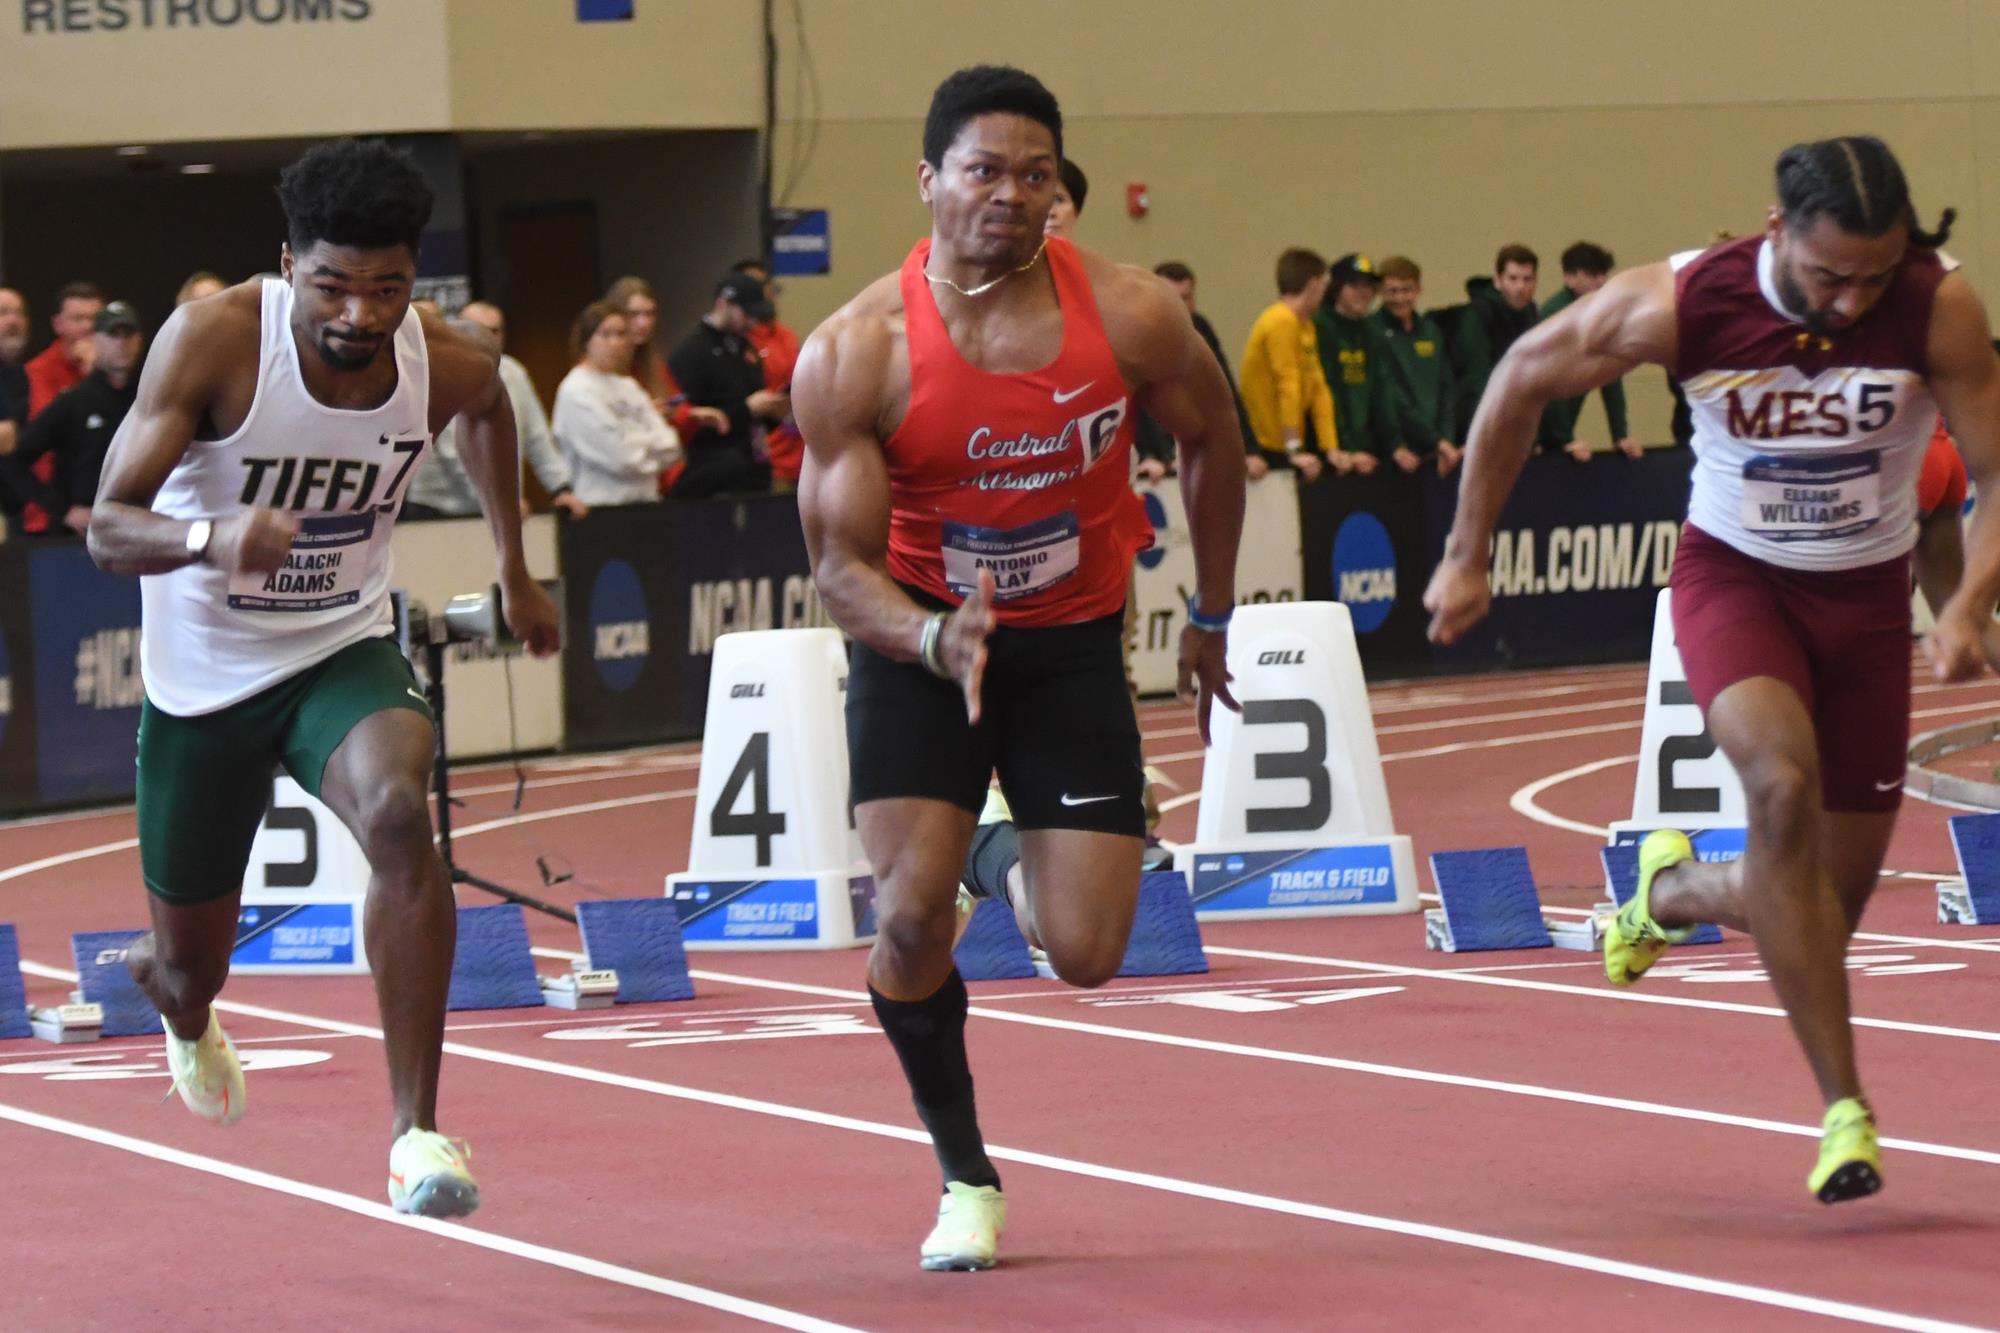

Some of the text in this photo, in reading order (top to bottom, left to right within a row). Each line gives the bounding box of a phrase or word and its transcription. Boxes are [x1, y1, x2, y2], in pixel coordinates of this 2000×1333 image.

[23, 0, 371, 33] RESTROOMS
[1727, 389, 1849, 439] MES
[1858, 384, 1896, 432] 5
[967, 418, 1077, 460] Central
[384, 440, 424, 499] 7
[240, 457, 395, 512] TIFFI
[1783, 488, 1841, 502] ELIJAH
[1760, 500, 1862, 523] WILLIAMS
[283, 552, 342, 570] ALACHI
[975, 551, 1048, 571] ANTONIO
[263, 572, 337, 593] ADAMS
[996, 570, 1031, 589] LAY
[1338, 568, 1397, 604] NCAA
[1257, 650, 1306, 665] GILL
[730, 683, 766, 698] GILL
[1658, 680, 1720, 813] 2
[1242, 698, 1331, 833] 3
[710, 732, 786, 867] 4
[1271, 869, 1326, 890] TRACK
[1343, 867, 1389, 887] FIELD
[778, 902, 815, 921] FIELD
